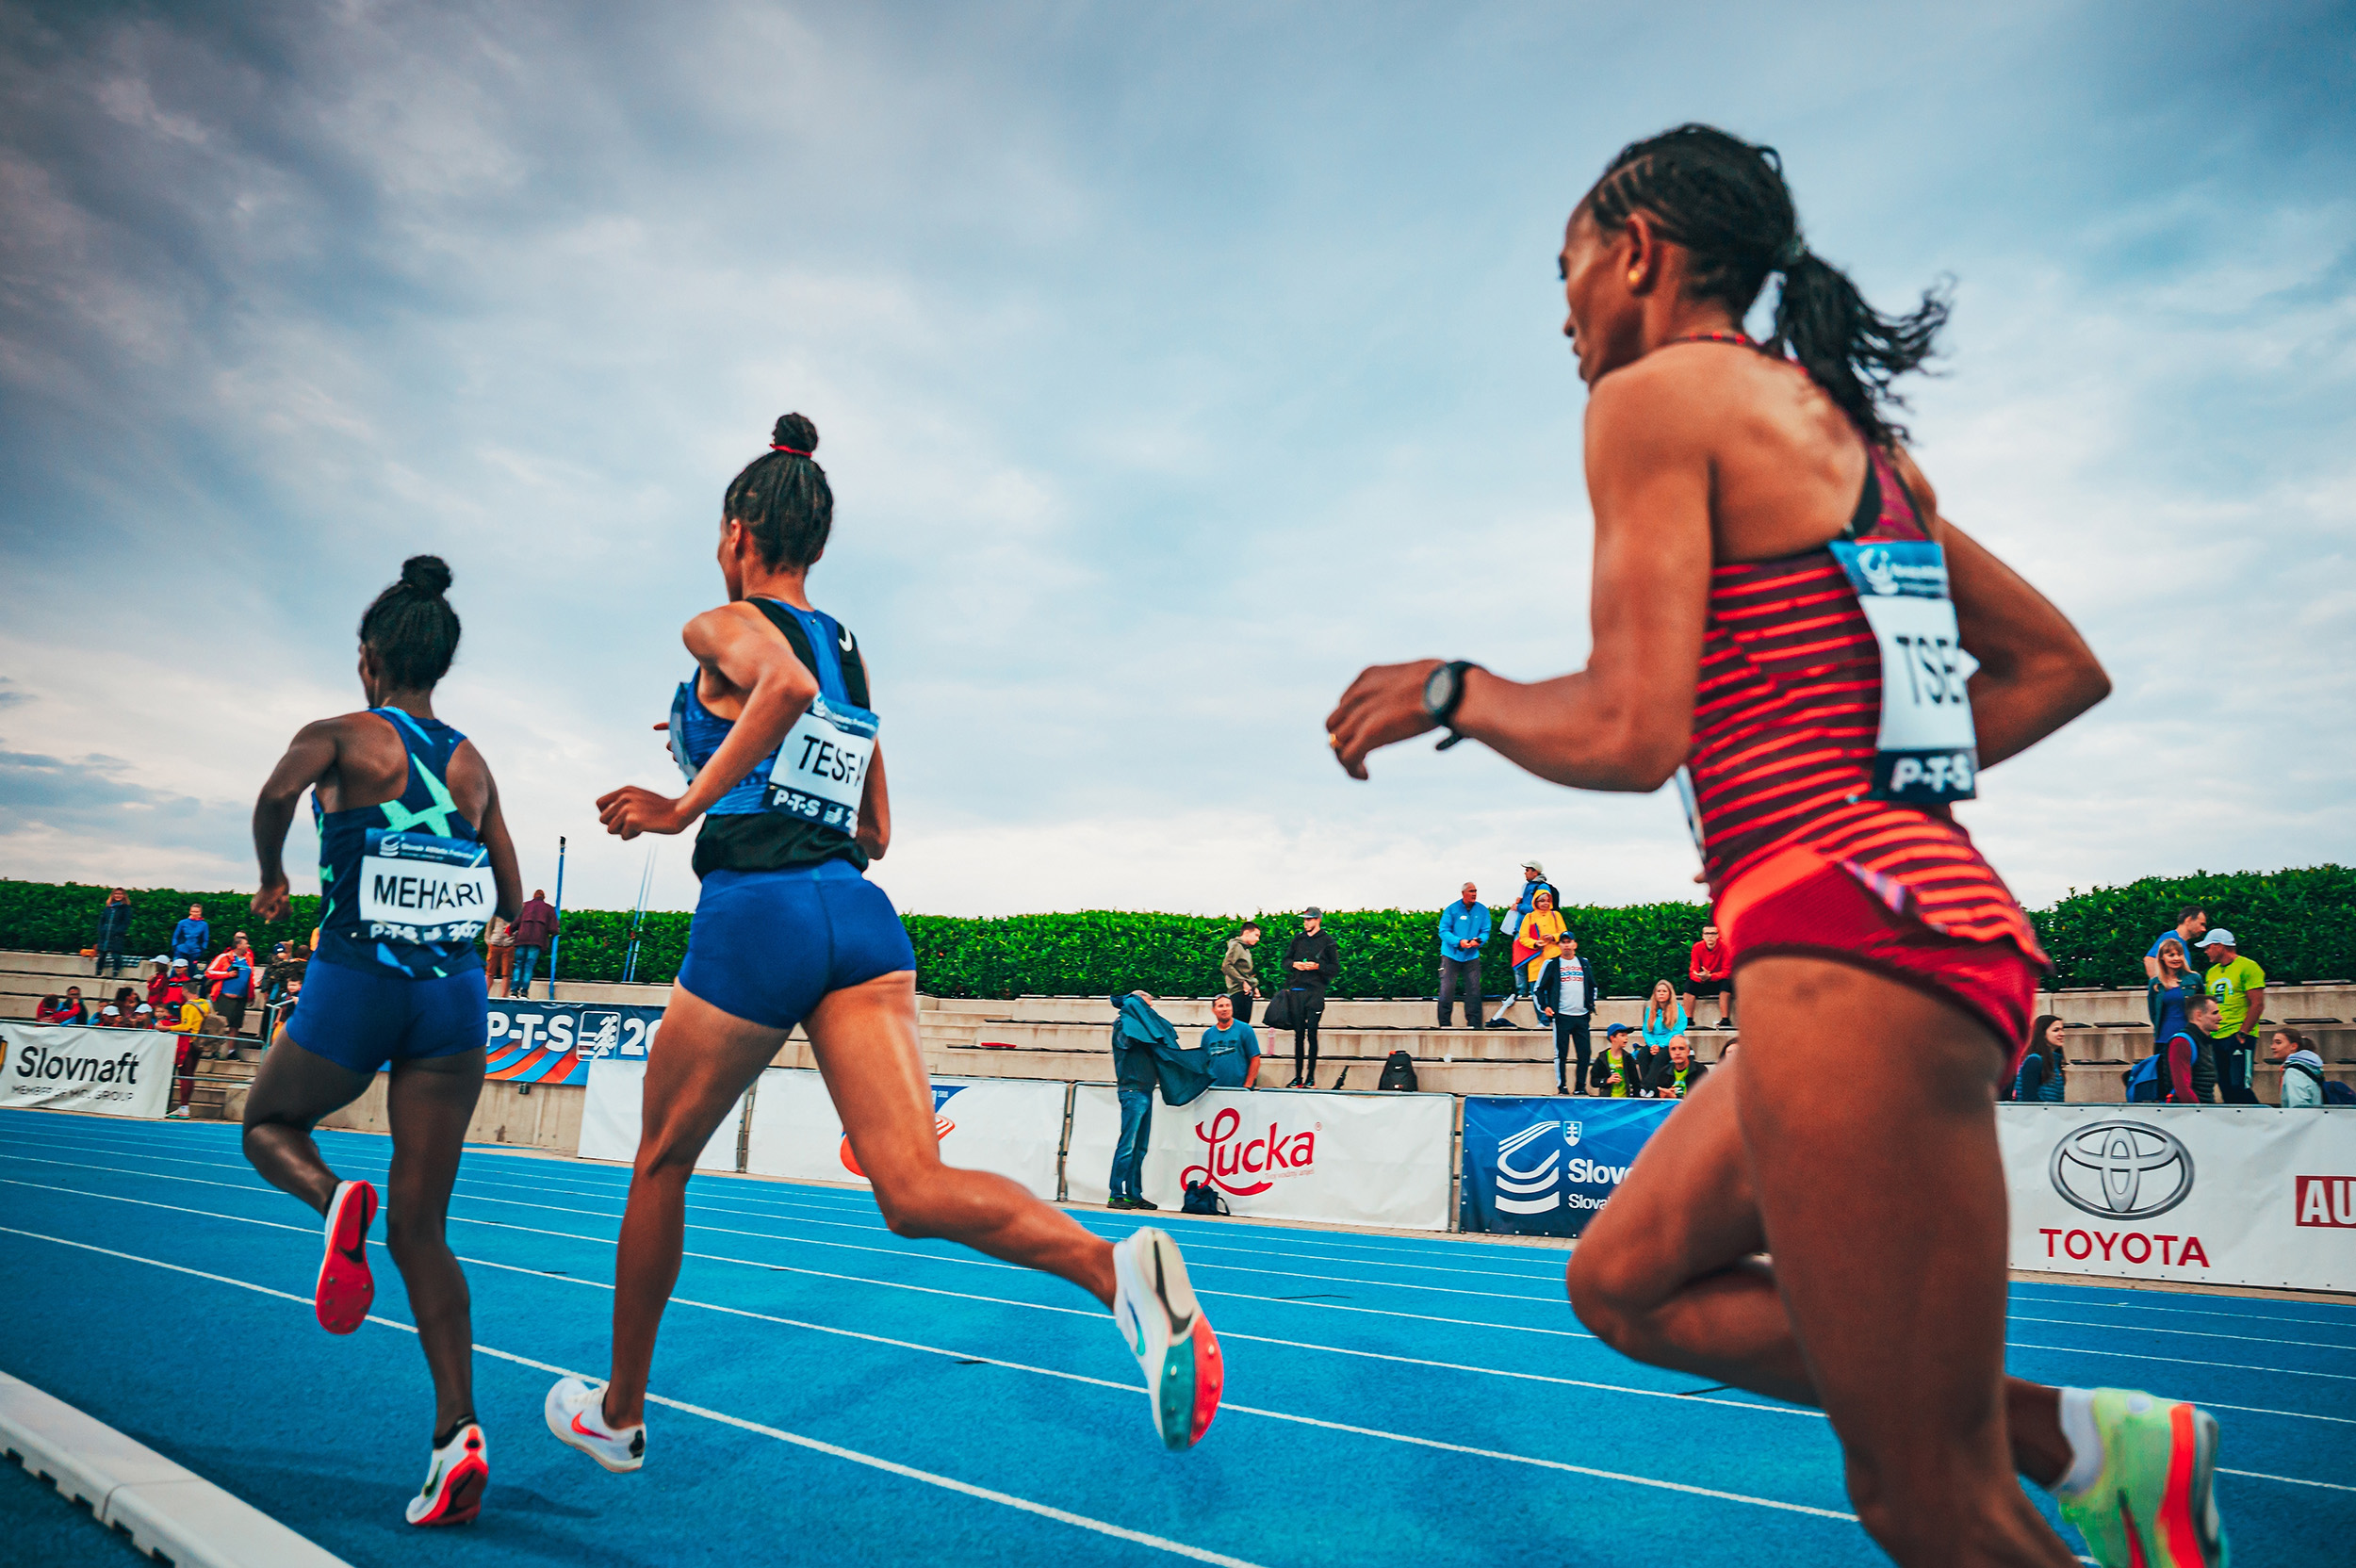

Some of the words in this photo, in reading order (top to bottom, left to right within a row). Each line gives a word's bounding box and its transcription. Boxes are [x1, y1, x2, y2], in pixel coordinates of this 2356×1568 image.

[374, 874, 483, 910] MEHARI
[486, 1011, 575, 1053] P-T-S
[16, 1045, 139, 1085] Slovnaft
[1180, 1107, 1316, 1197] Lucka
[2039, 1228, 2211, 1268] TOYOTA
